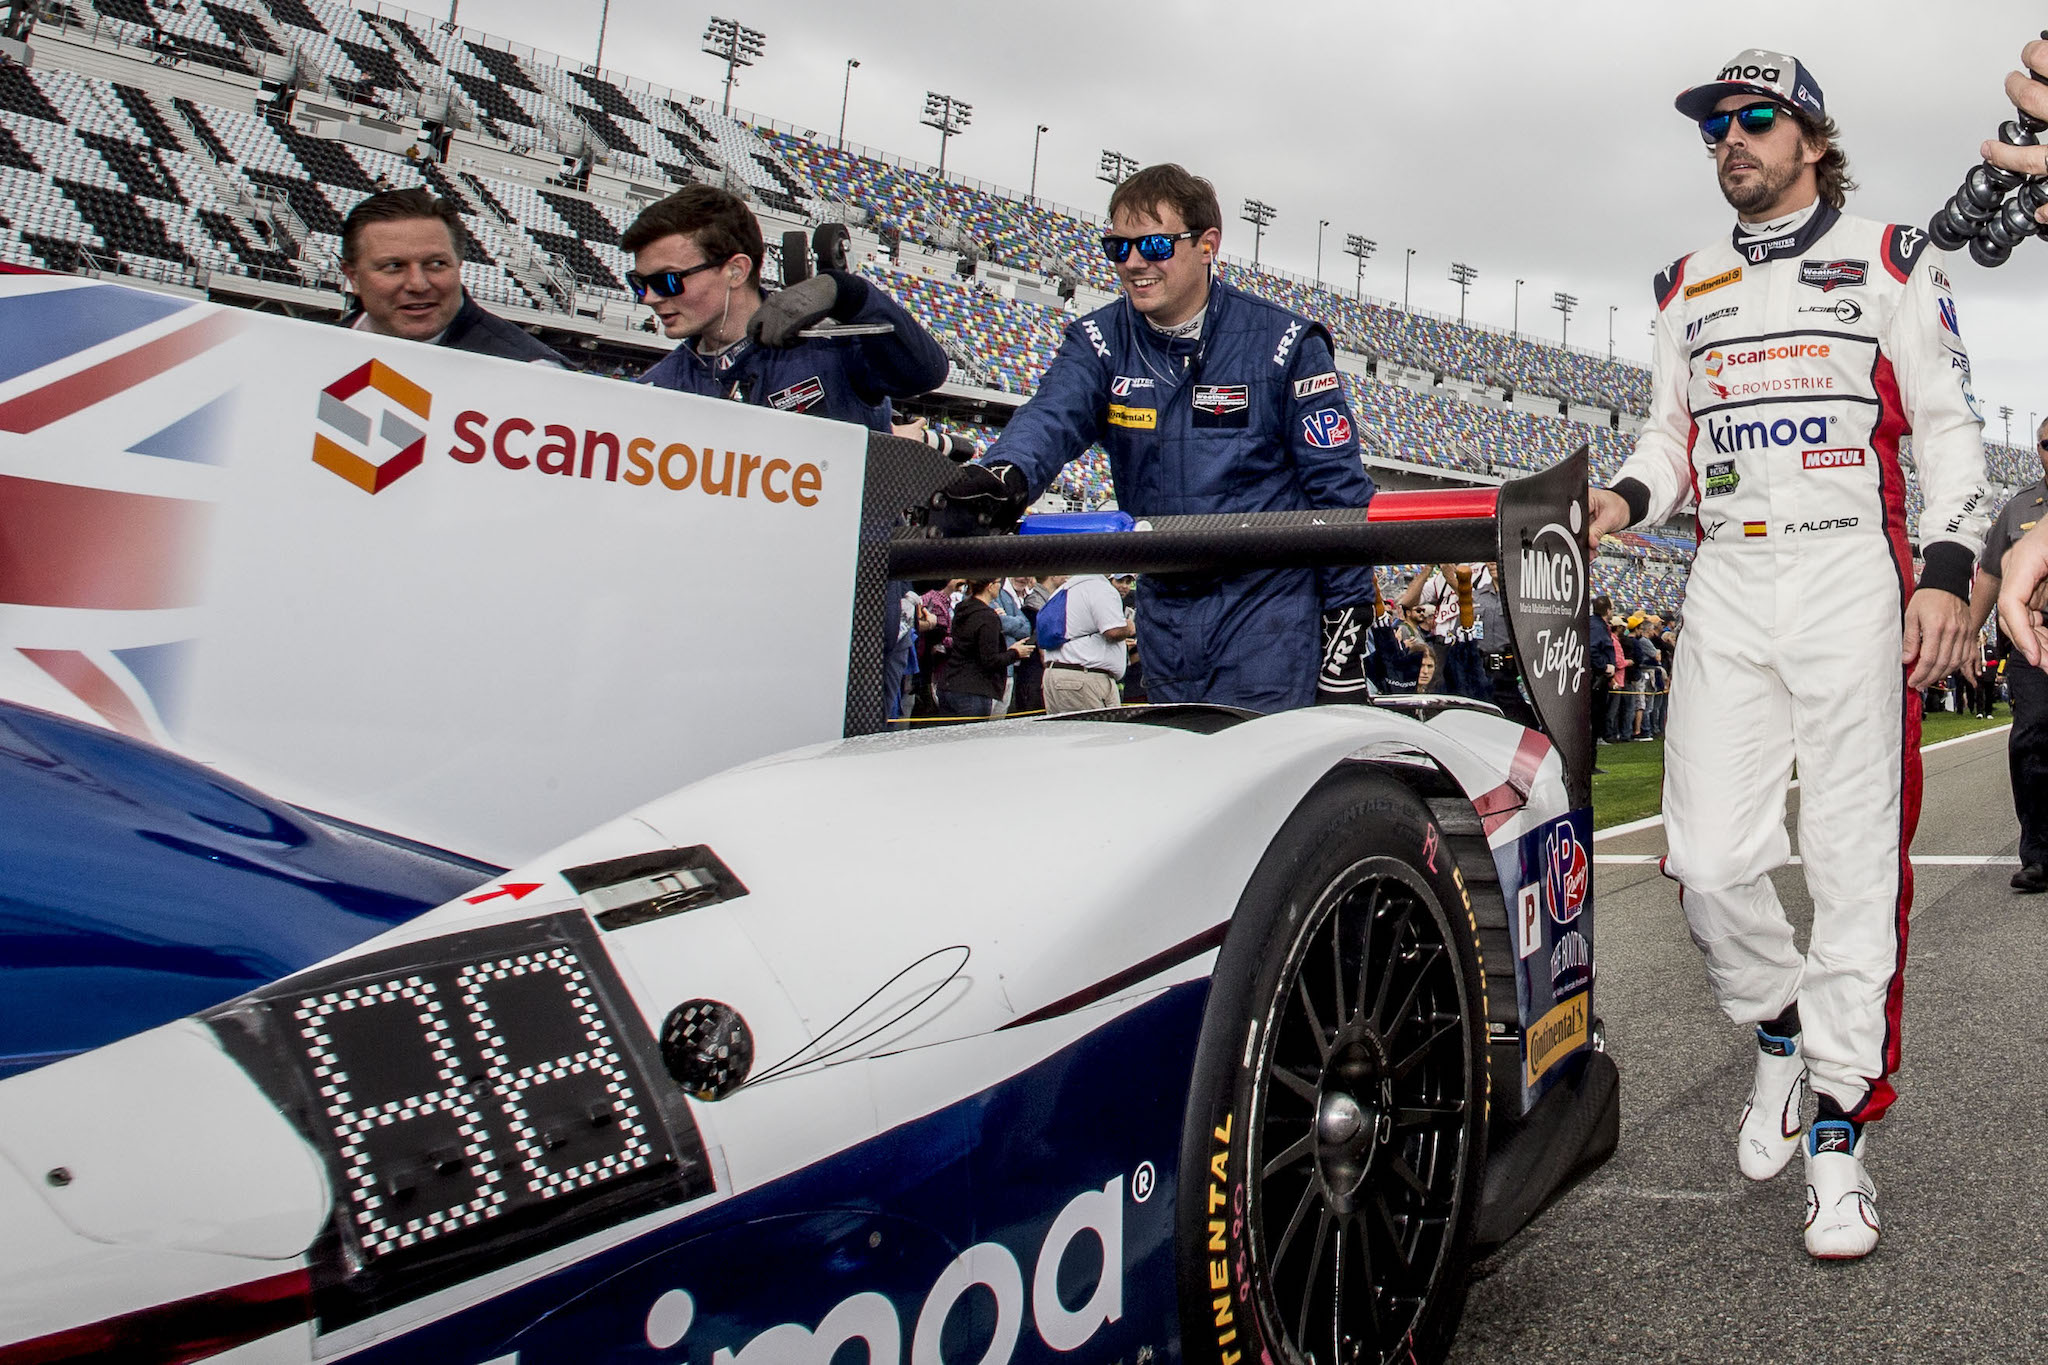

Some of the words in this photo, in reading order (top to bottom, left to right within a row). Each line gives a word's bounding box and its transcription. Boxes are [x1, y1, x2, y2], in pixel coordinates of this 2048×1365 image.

[1686, 273, 1731, 297] Continental
[1704, 306, 1739, 321] UNITED
[1082, 320, 1111, 357] HRX
[1273, 320, 1302, 367] HRX
[1727, 344, 1830, 366] scansource
[1302, 408, 1340, 447] VP
[1708, 415, 1827, 454] kimoa
[447, 409, 823, 508] scansource
[1805, 450, 1863, 467] MOTUL
[1784, 523, 1796, 534] F.
[1799, 517, 1859, 532] ALONSO
[1520, 549, 1573, 602] MMCG
[1327, 619, 1362, 676] HRX
[1533, 626, 1586, 696] Jetfly
[1546, 820, 1575, 923] VP
[1525, 893, 1536, 947] P
[1531, 1005, 1575, 1076] Continental
